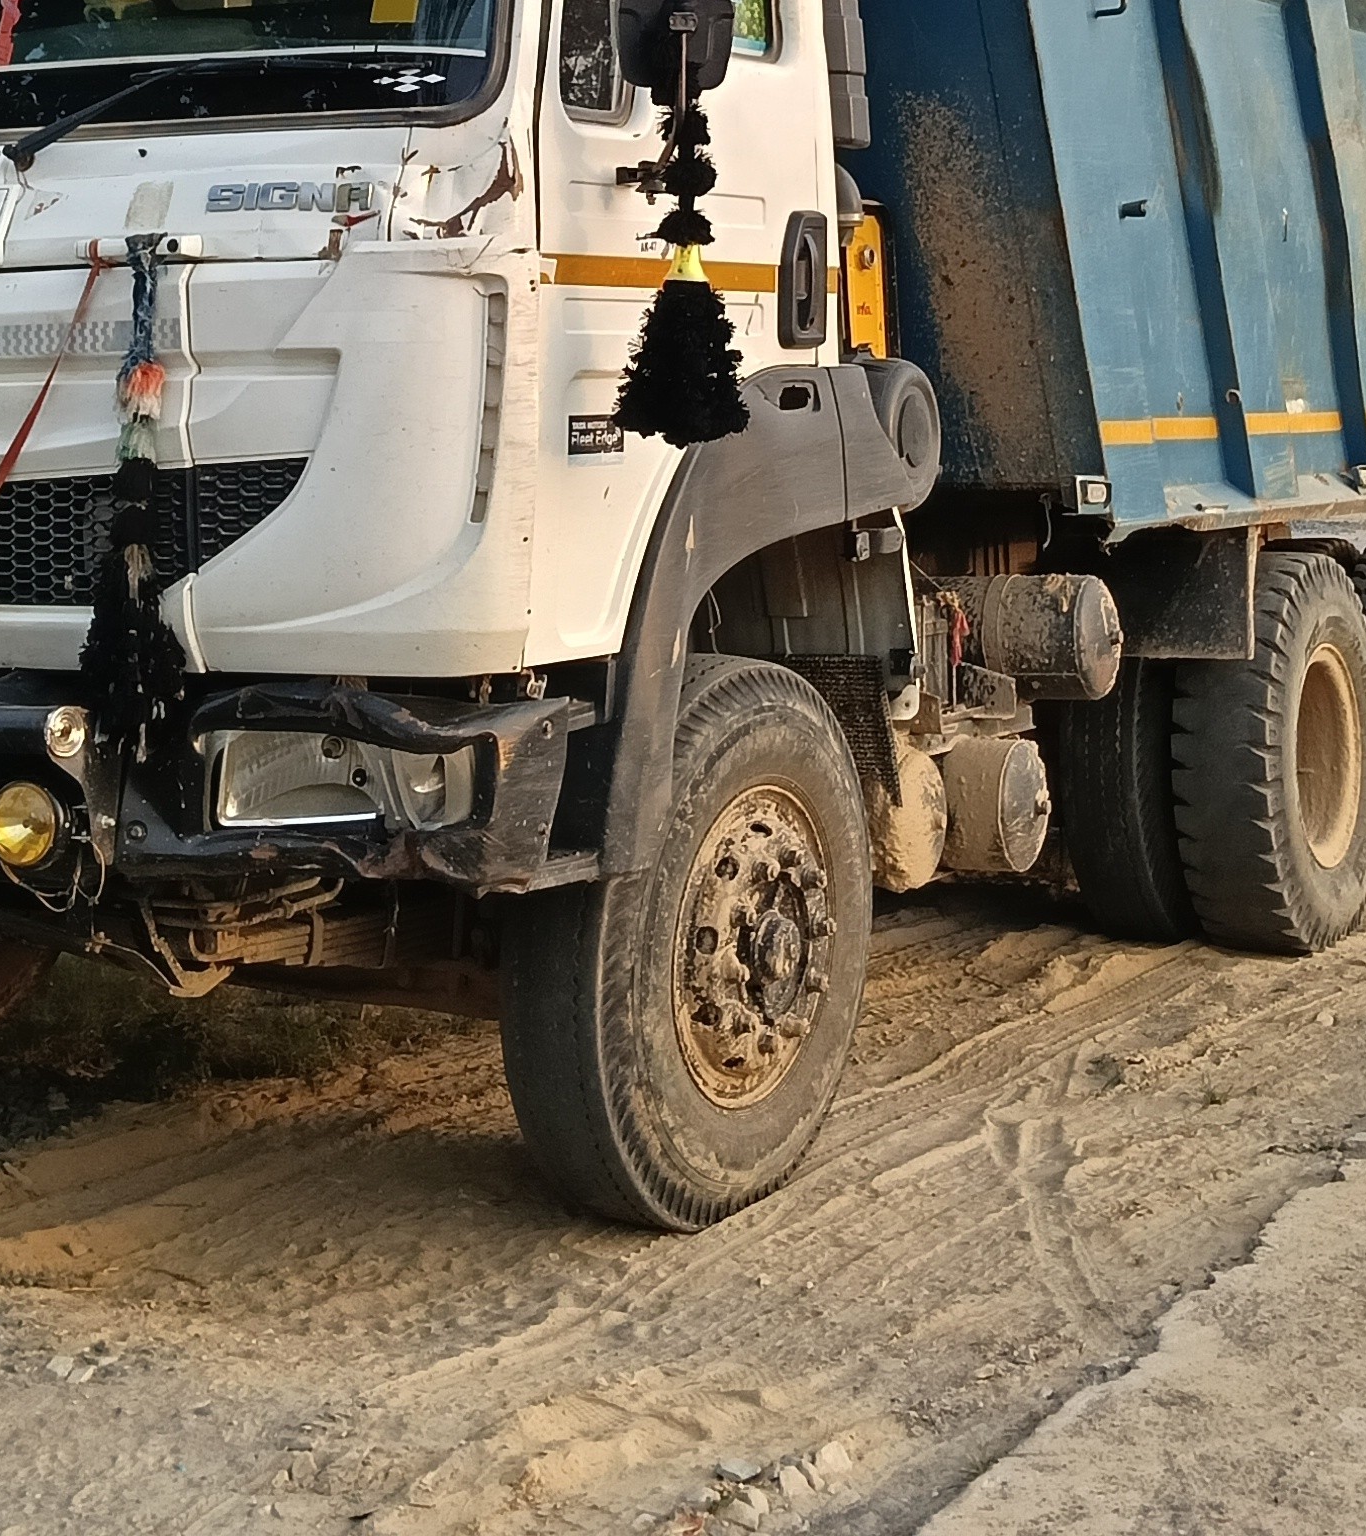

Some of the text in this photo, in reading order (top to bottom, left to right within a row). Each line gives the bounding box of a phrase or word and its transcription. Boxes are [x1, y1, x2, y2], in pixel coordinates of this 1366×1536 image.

[206, 181, 375, 213] SIGNA
[571, 430, 619, 446] Fleet Edge
